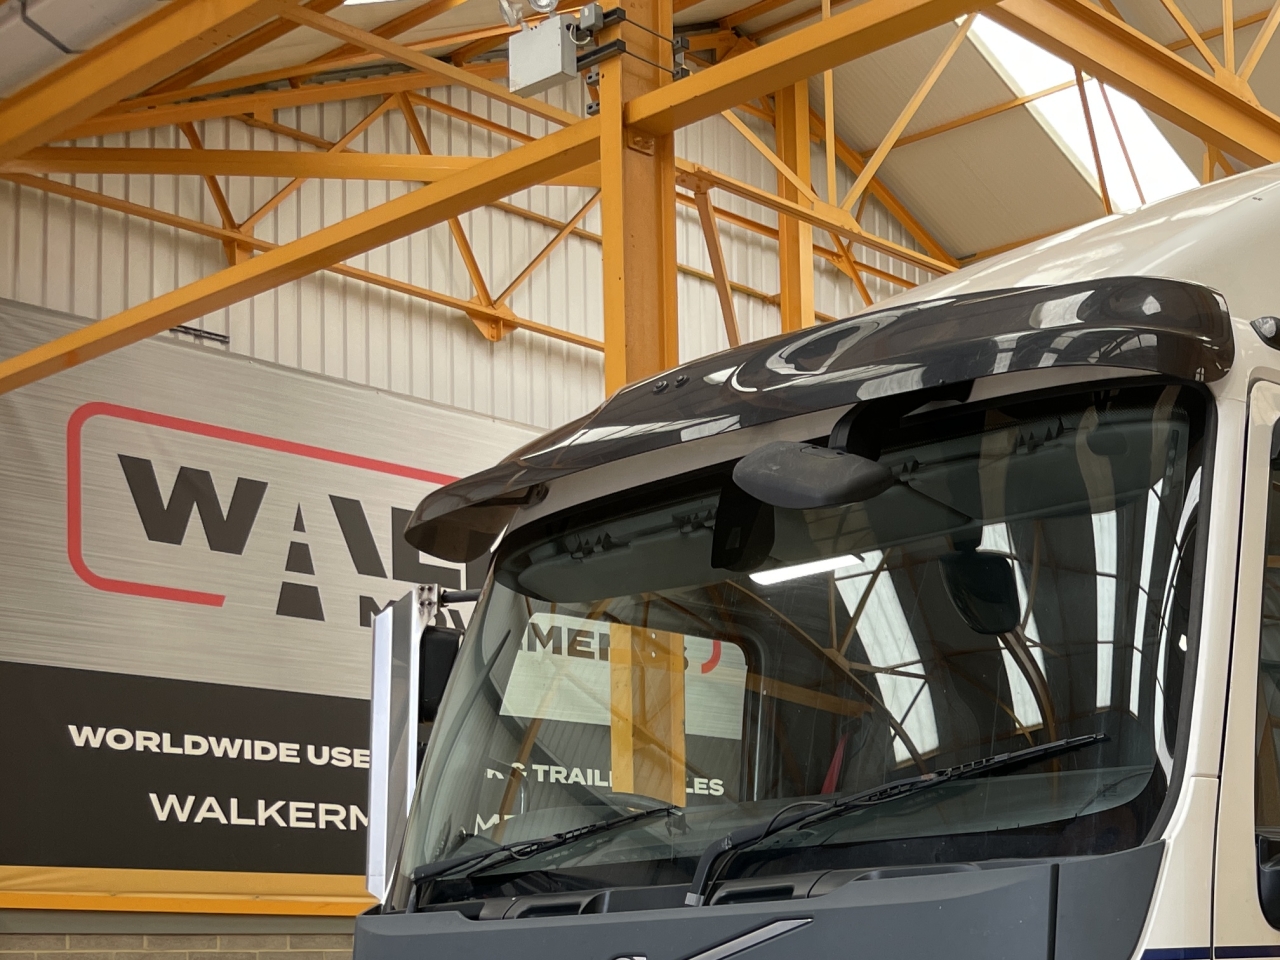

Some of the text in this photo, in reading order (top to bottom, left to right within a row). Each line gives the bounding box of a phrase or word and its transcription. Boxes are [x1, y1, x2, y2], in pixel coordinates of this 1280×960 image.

[68, 724, 370, 768] WORLDWIDE USE
[532, 764, 612, 787] TRAIL
